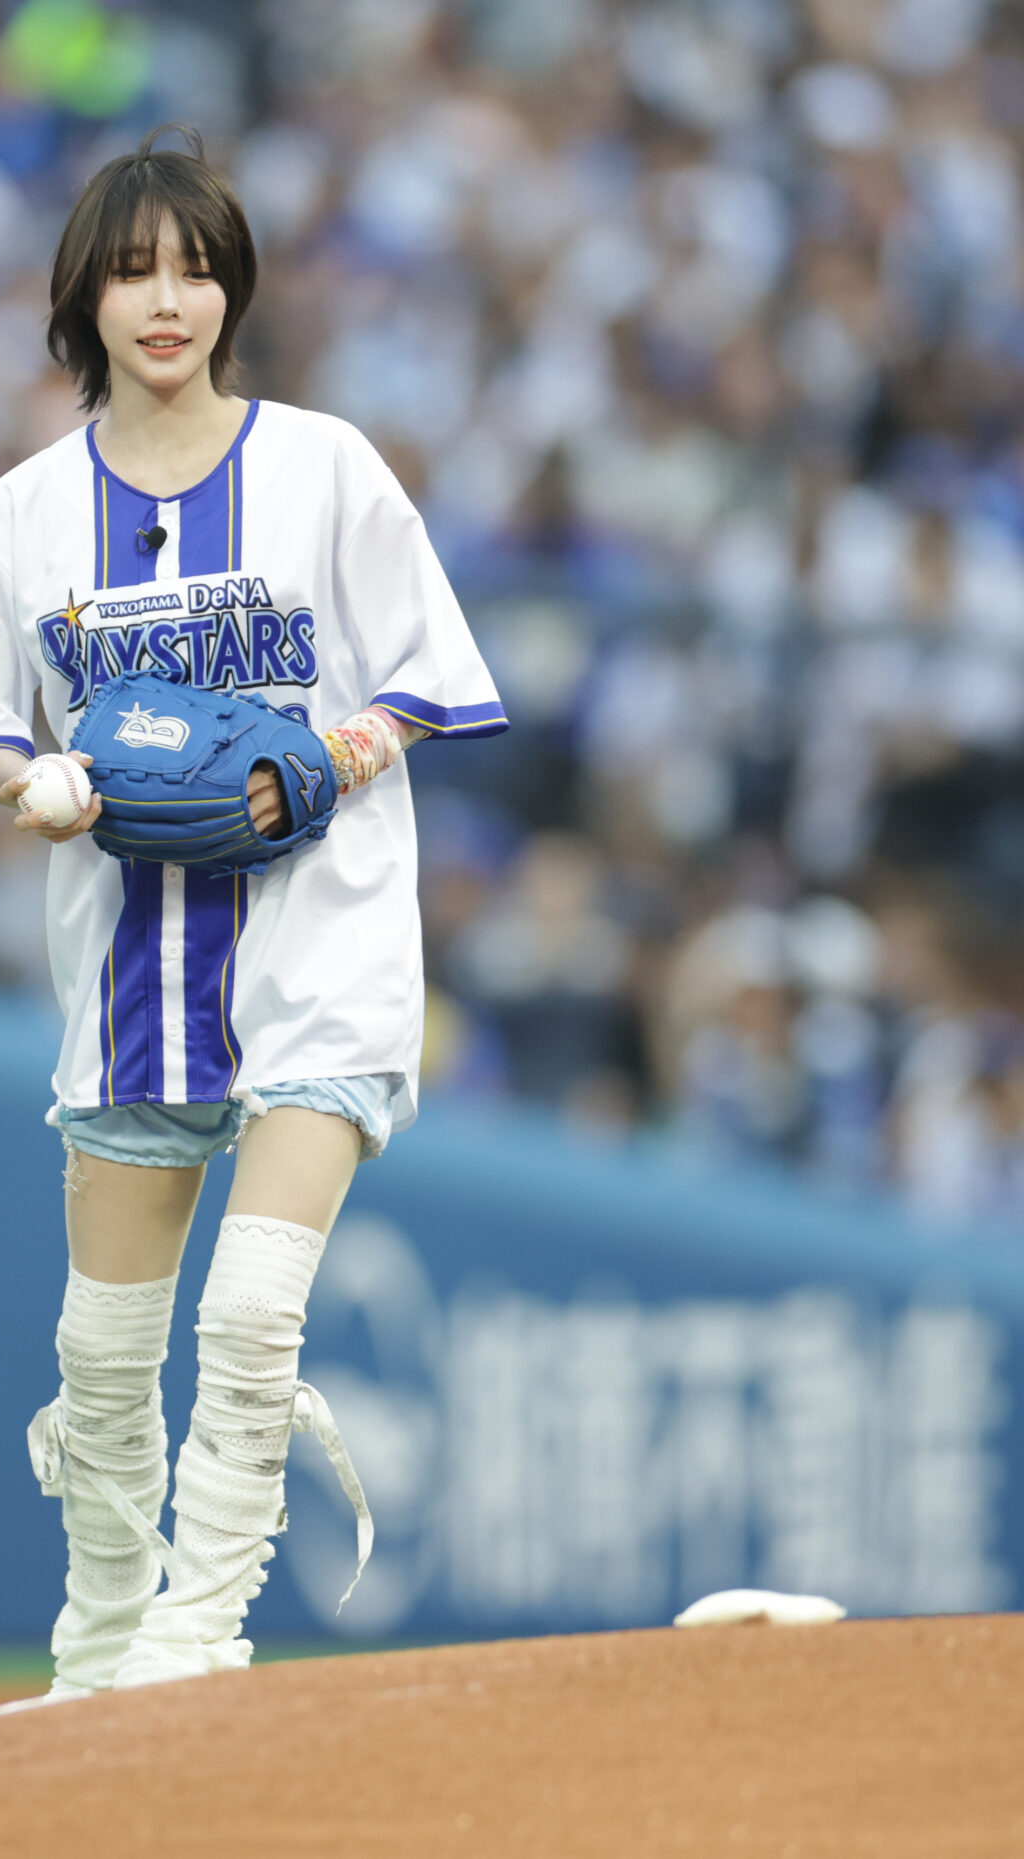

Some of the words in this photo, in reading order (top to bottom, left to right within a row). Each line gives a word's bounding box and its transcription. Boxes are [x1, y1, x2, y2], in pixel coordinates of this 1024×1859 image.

[96, 594, 183, 618] YOKOHAMA
[188, 577, 273, 614] DeNA
[36, 606, 319, 712] BAYSTARS
